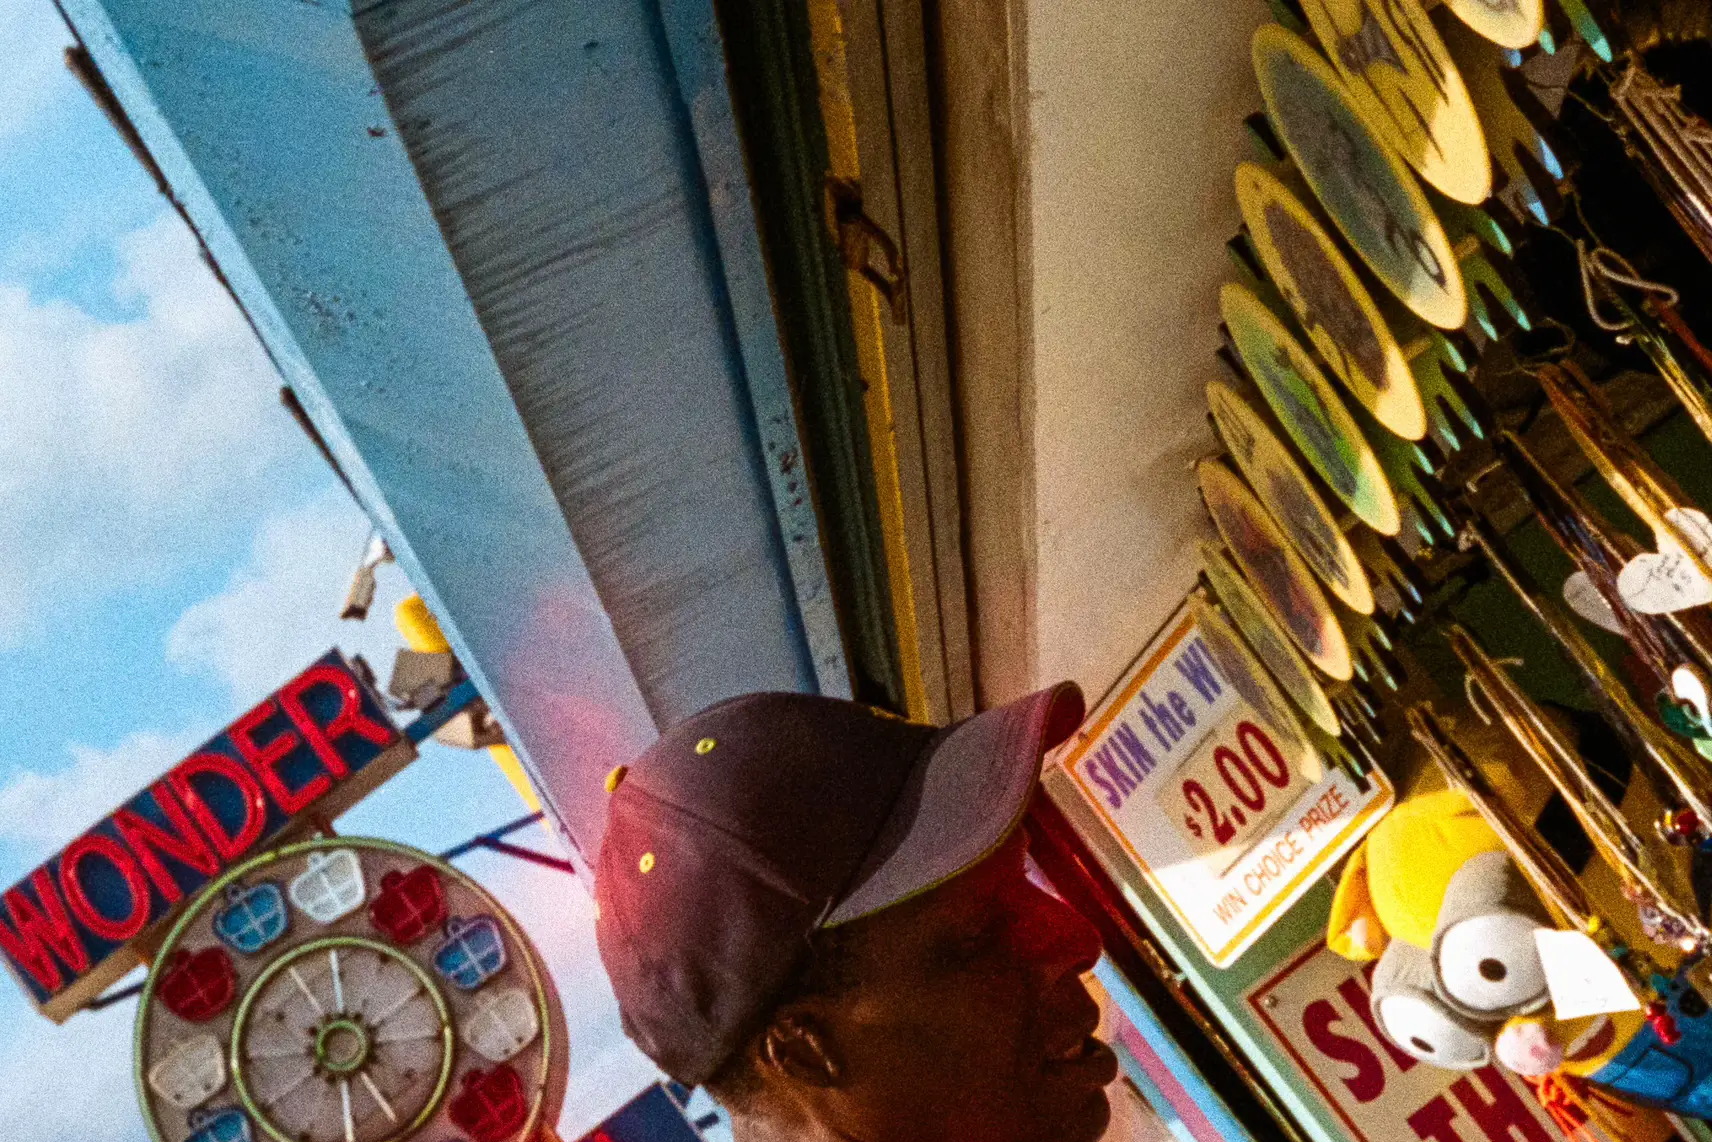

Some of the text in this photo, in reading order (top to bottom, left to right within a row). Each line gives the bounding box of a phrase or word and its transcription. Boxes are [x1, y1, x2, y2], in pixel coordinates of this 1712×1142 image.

[1084, 721, 1157, 809] SKIN
[1138, 690, 1197, 753] the
[1182, 720, 1291, 846] $2.00
[0, 664, 393, 992] WONDER
[1212, 783, 1350, 925] WIN CHOICE PRIZE
